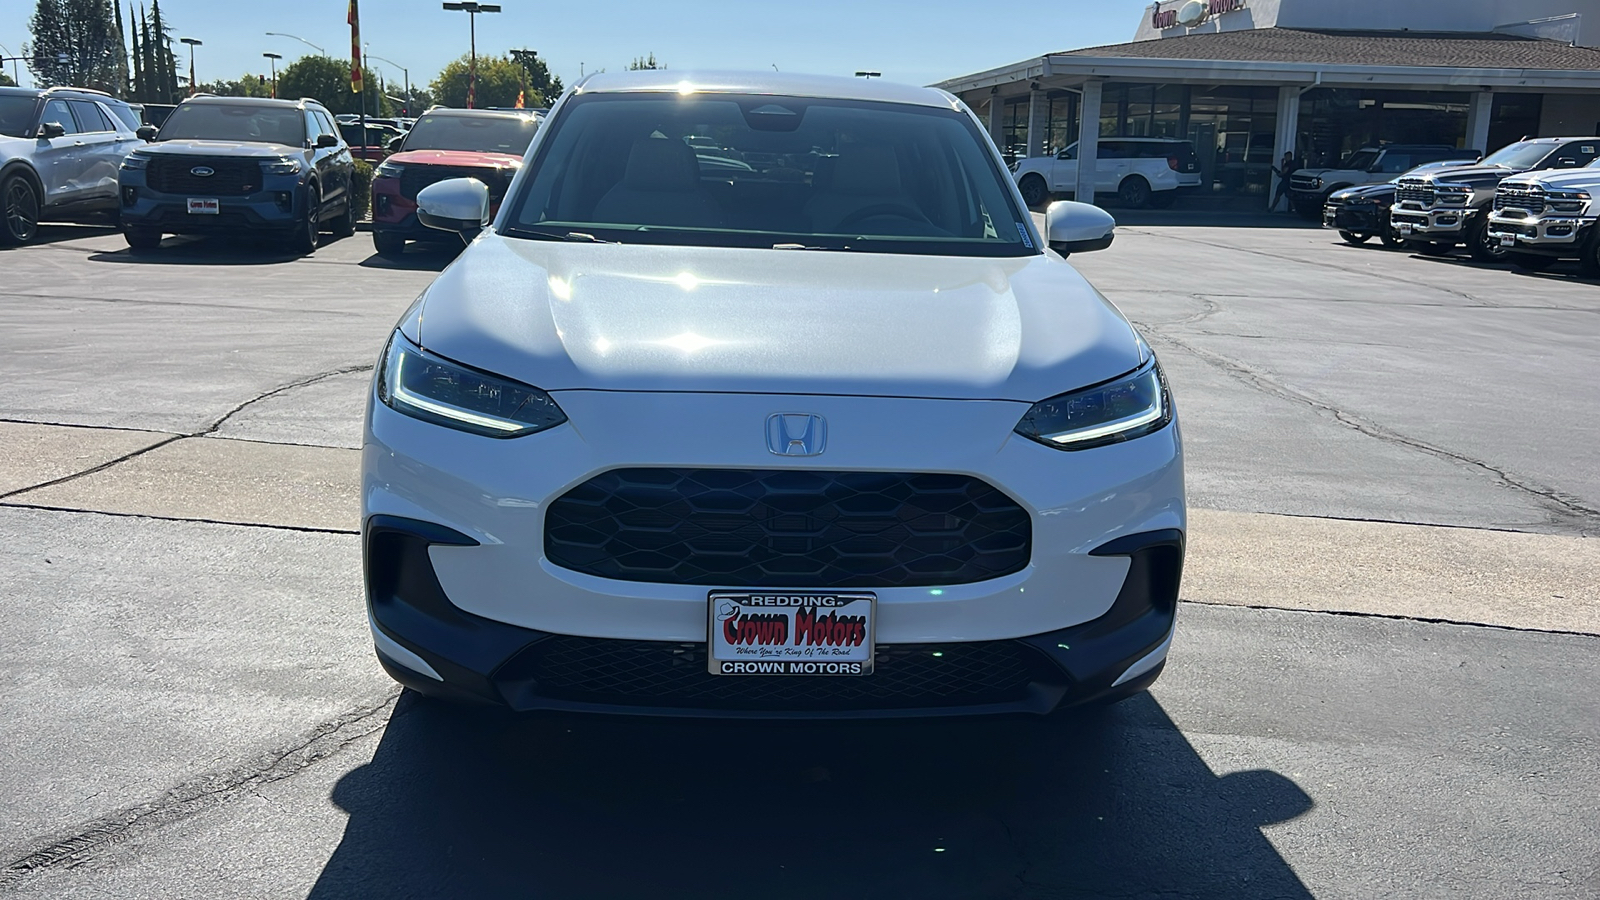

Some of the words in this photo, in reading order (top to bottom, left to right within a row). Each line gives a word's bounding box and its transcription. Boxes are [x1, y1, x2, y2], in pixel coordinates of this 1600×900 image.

[751, 596, 836, 606] REDDING
[723, 612, 789, 646] Crown
[794, 606, 867, 647] Motors
[736, 647, 758, 655] Where
[759, 647, 783, 658] You're
[784, 648, 802, 656] King
[804, 648, 814, 656] Of
[816, 647, 830, 655] The
[831, 648, 851, 656] Road
[721, 662, 785, 674] CROWN
[789, 662, 862, 674] MOTORS
